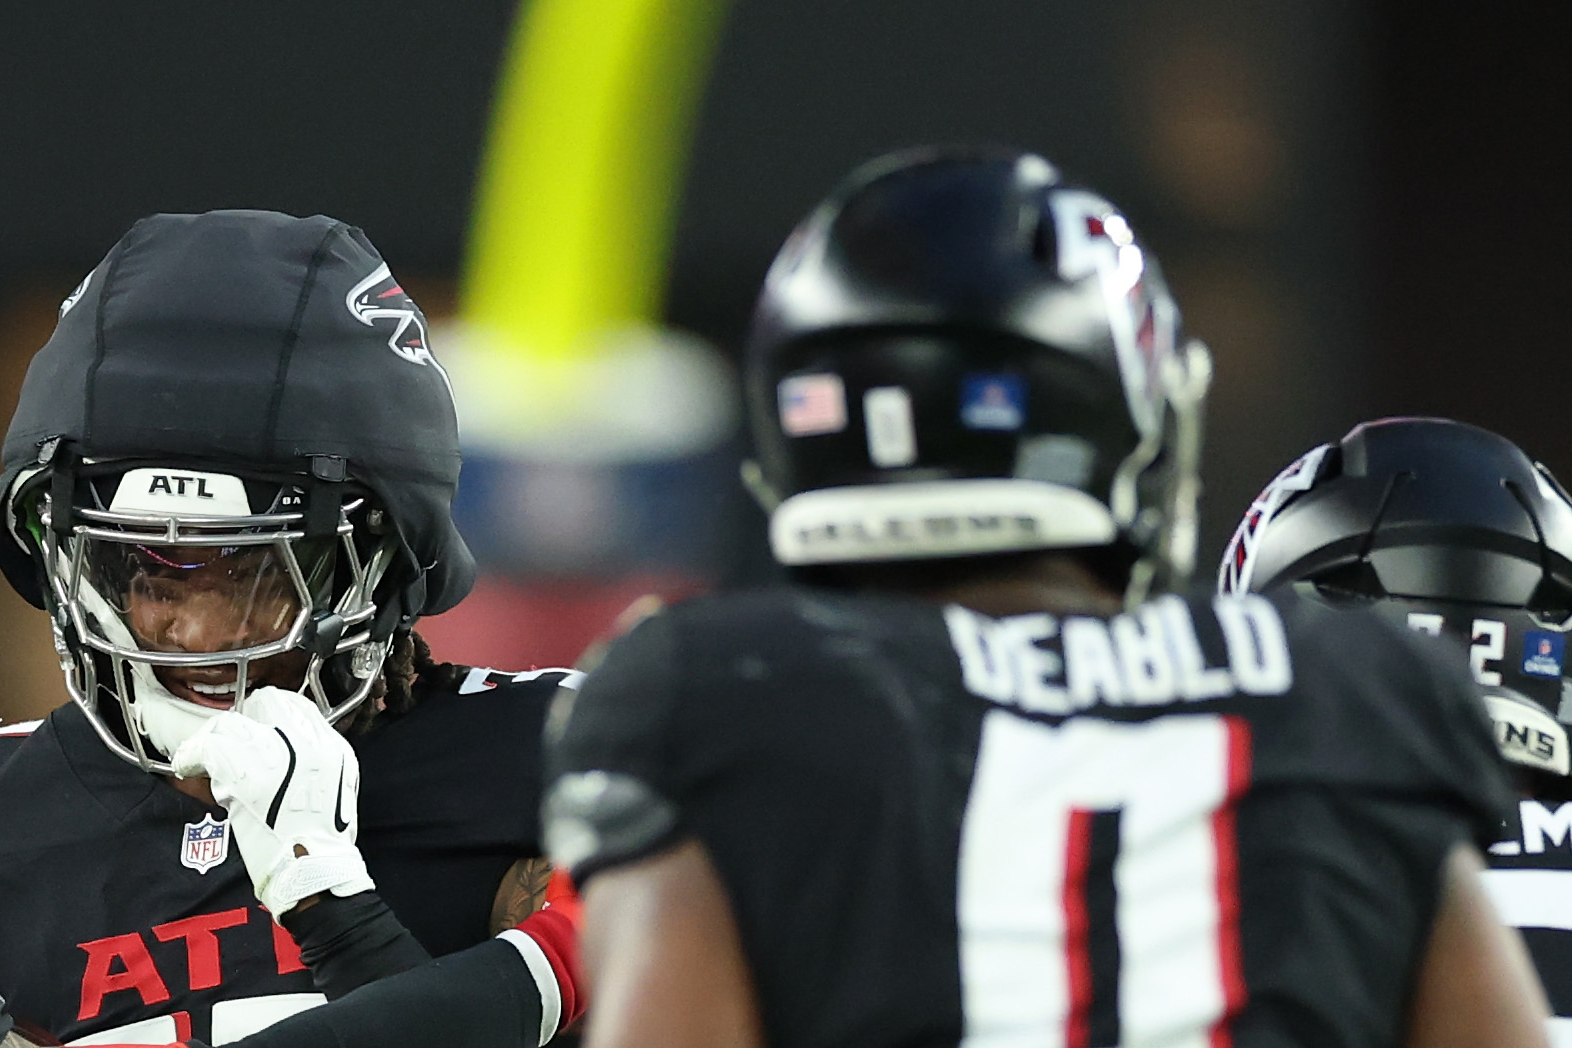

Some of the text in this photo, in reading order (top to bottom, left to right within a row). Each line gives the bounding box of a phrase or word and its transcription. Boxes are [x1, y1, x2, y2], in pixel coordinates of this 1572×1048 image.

[148, 475, 214, 499] ATL
[941, 592, 1294, 717] DEABLO
[190, 840, 221, 863] NFL
